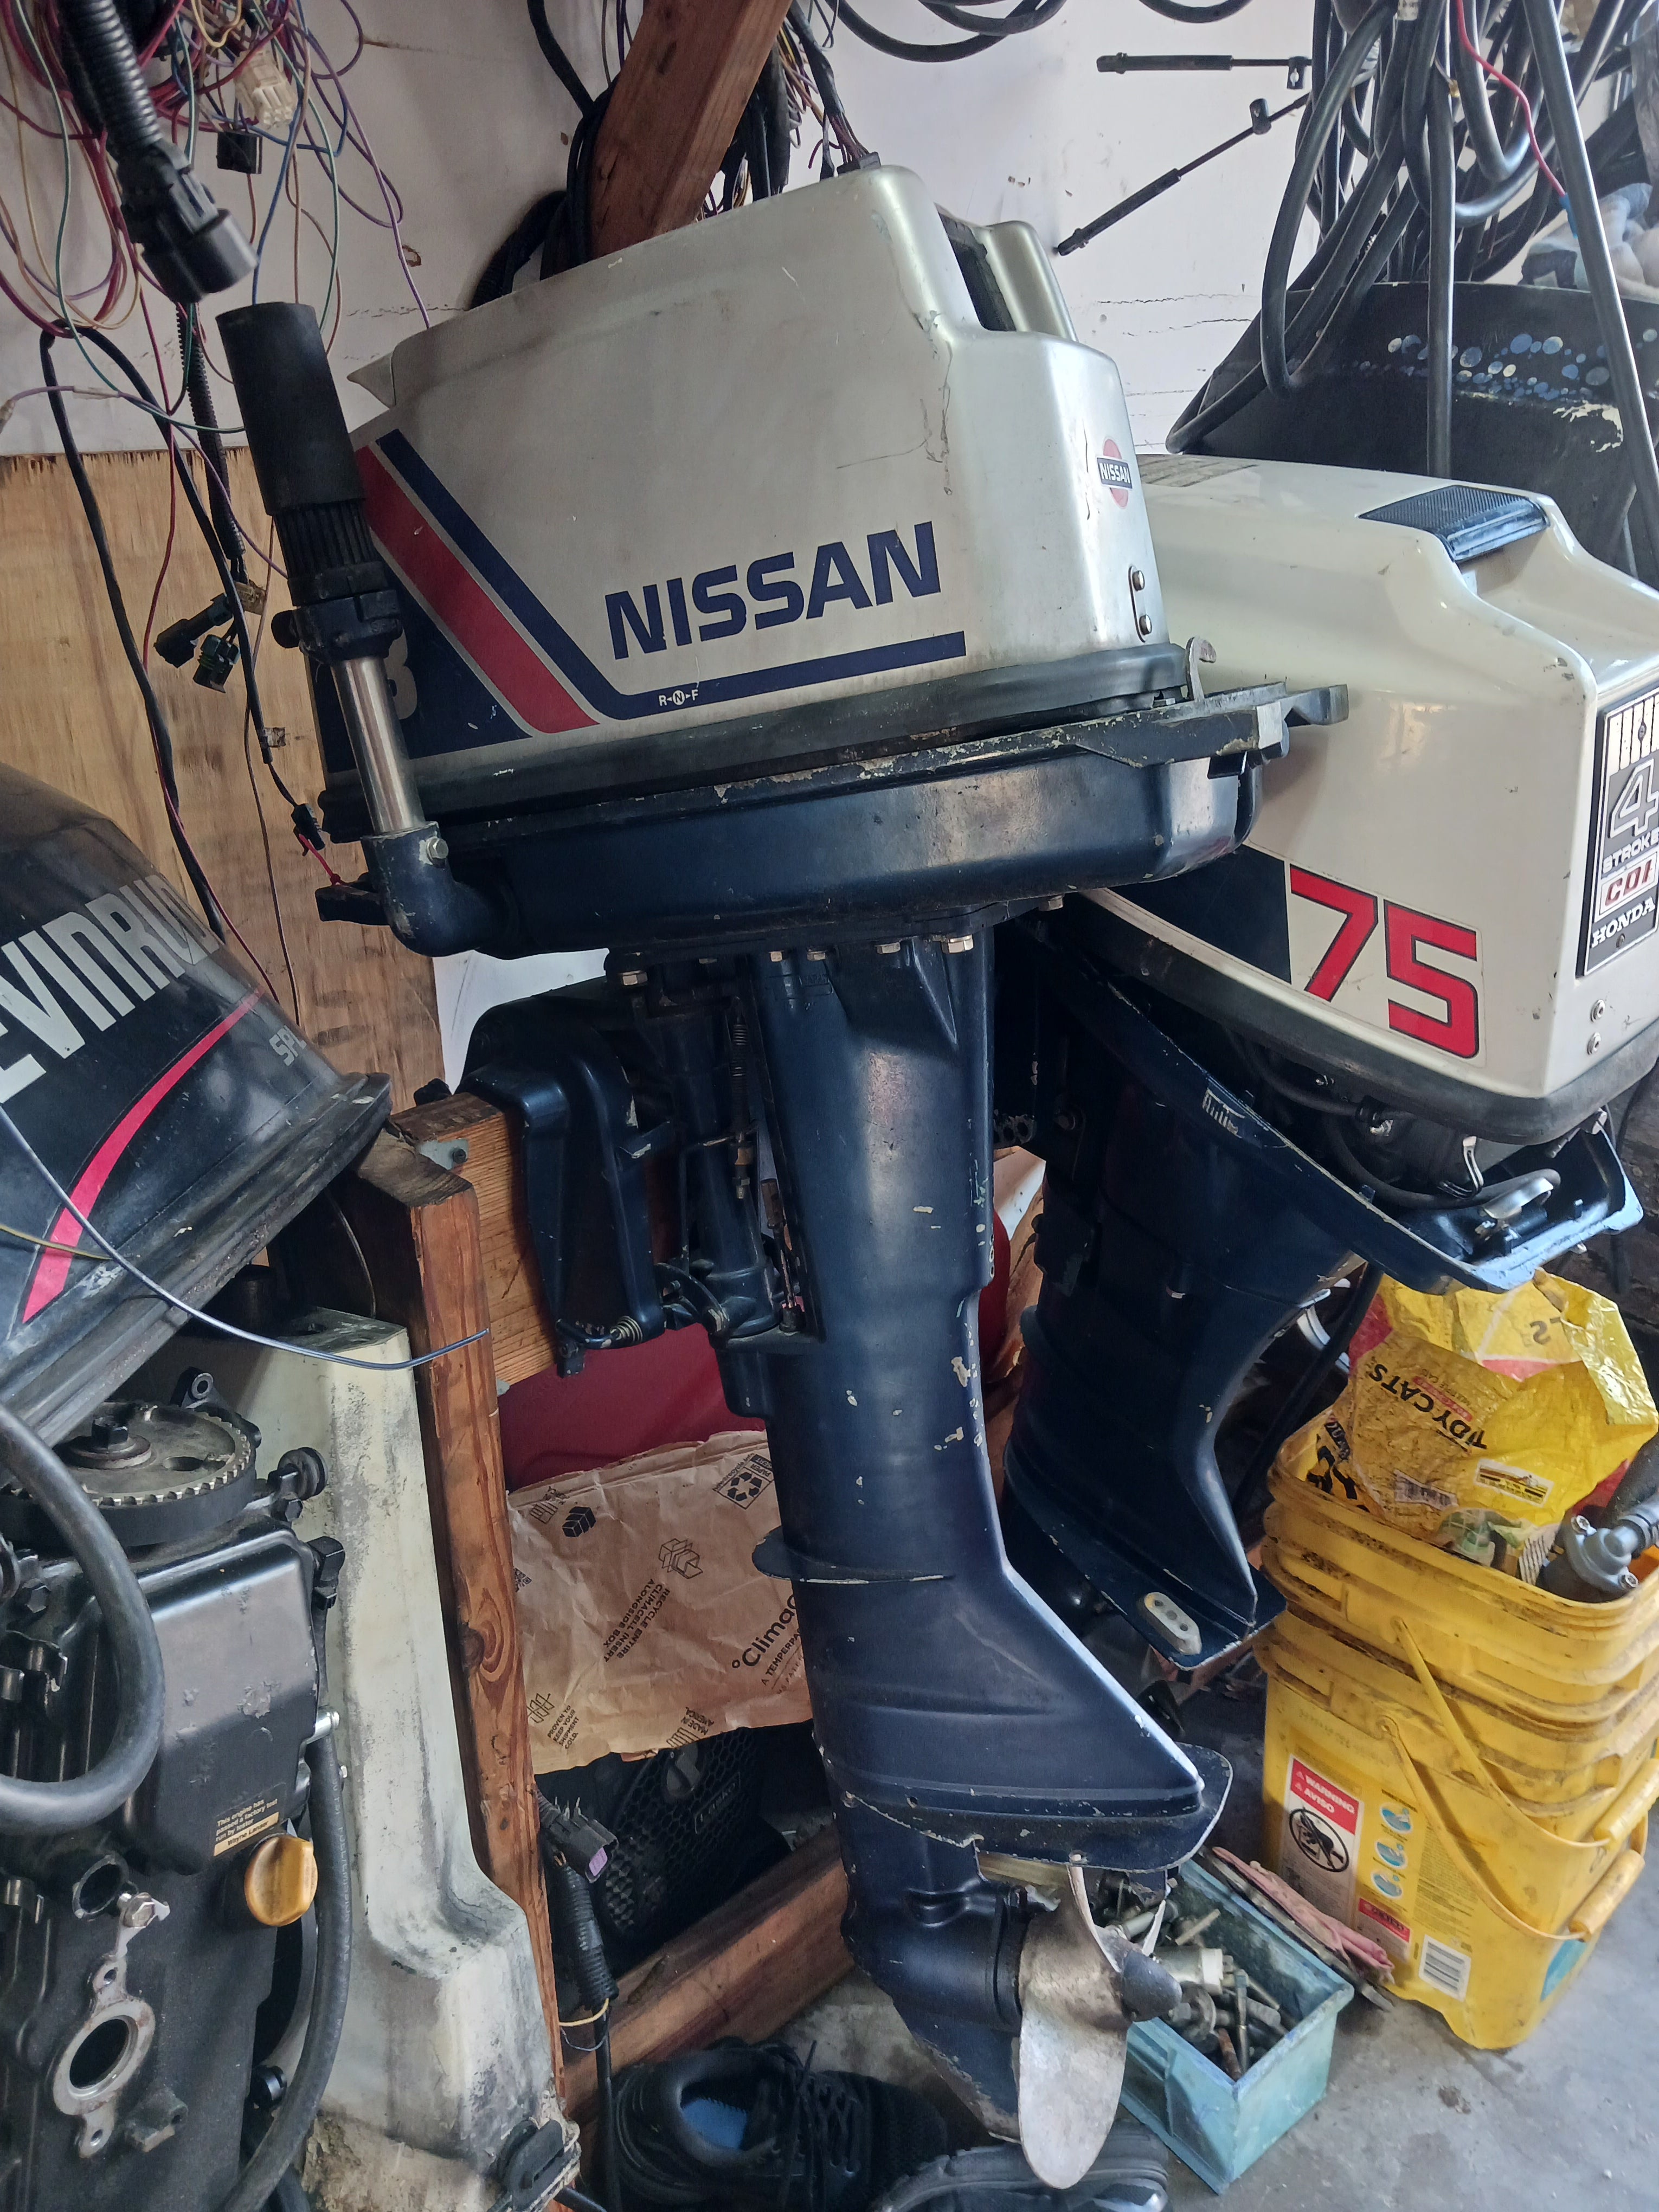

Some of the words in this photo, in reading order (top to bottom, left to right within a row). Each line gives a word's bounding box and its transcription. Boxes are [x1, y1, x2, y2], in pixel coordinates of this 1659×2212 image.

[1099, 462, 1131, 484] NISSAN
[605, 521, 941, 660] NISSAN
[659, 695, 668, 706] R
[691, 689, 698, 701] F
[1609, 758, 1659, 839] 4
[1603, 826, 1659, 874] STROKE
[1605, 859, 1653, 907] CDI
[1590, 896, 1656, 948] HONDA
[1290, 863, 1479, 1059] 75
[1368, 1364, 1435, 1412] CATS
[1432, 1409, 1488, 1450] TIDY
[619, 1578, 655, 1628] ALONGSIDE
[627, 1584, 663, 1630] CLIMACELL
[640, 1588, 671, 1629] RECYCLE
[603, 1629, 621, 1648] BOX
[603, 1632, 629, 1663] INSERT
[616, 1628, 642, 1659] ENTIRE
[761, 1678, 769, 1686] A
[547, 1713, 565, 1738] PROVEN
[563, 1705, 571, 1714] TO
[553, 1726, 564, 1742] KEEP
[562, 1709, 576, 1726] YOUR
[558, 1716, 580, 1746] SHIPMENT
[680, 1716, 690, 1724] IN
[687, 1720, 709, 1735] MADE
[1303, 1787, 1335, 1814] AVISO
[1304, 1774, 1355, 1815] WARNING
[216, 1818, 239, 1836] passed
[245, 1805, 266, 1819] factory
[217, 1817, 231, 1827] This
[232, 1806, 253, 1819] engine
[253, 1799, 265, 1808] has
[216, 1833, 227, 1842] run
